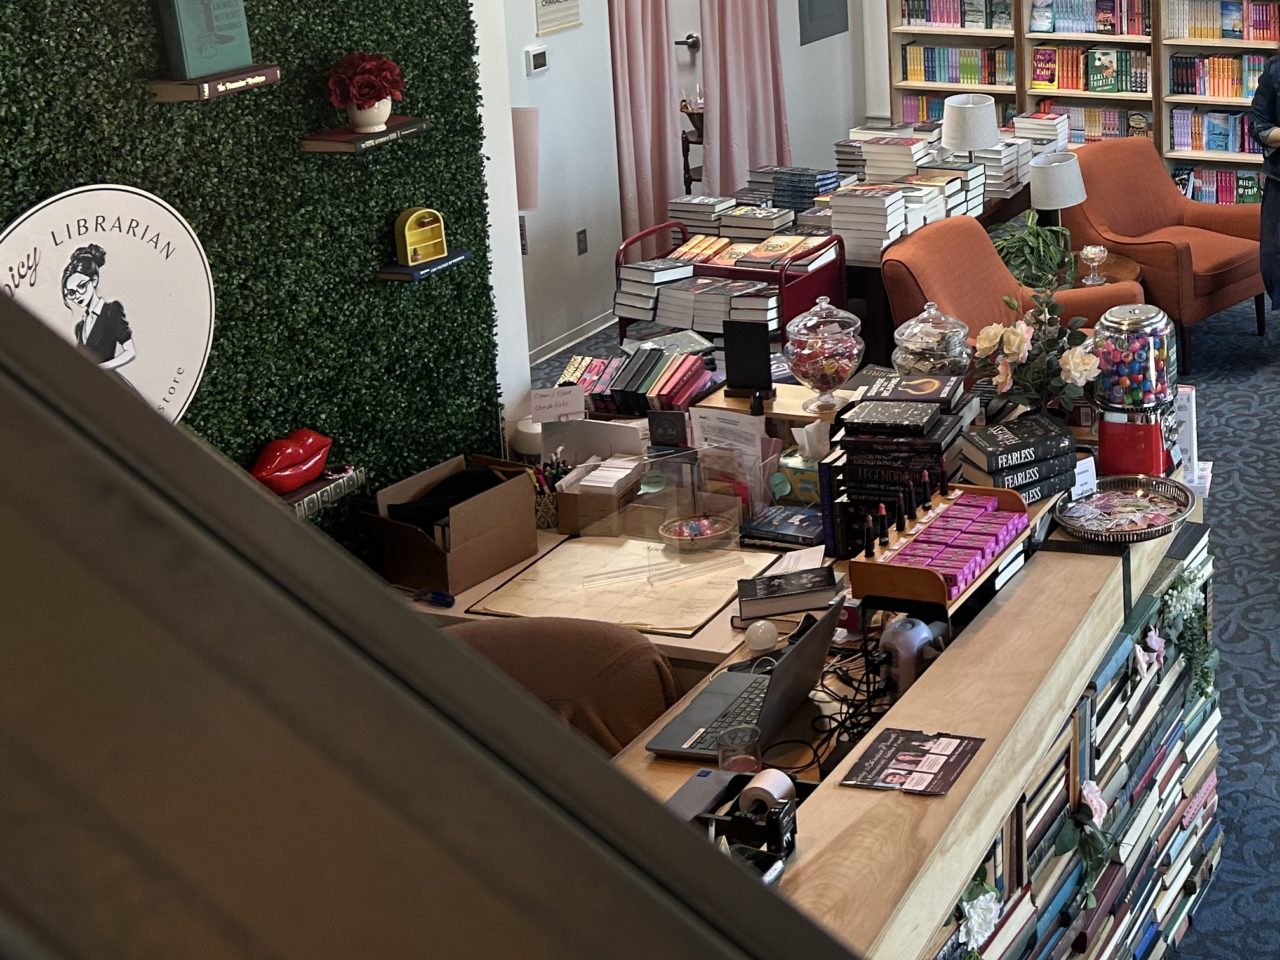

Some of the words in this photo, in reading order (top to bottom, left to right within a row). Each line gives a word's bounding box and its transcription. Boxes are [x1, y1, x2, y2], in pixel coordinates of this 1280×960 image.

[1090, 78, 1115, 87] THIRTIES
[1238, 179, 1252, 187] KILT
[1244, 187, 1257, 195] TRIP
[51, 215, 176, 261] LIBRARIAN
[0, 246, 42, 298] icy
[998, 448, 1035, 469] FEARLESS
[1004, 467, 1039, 489] FEARLESS
[1021, 486, 1041, 504] RLESS
